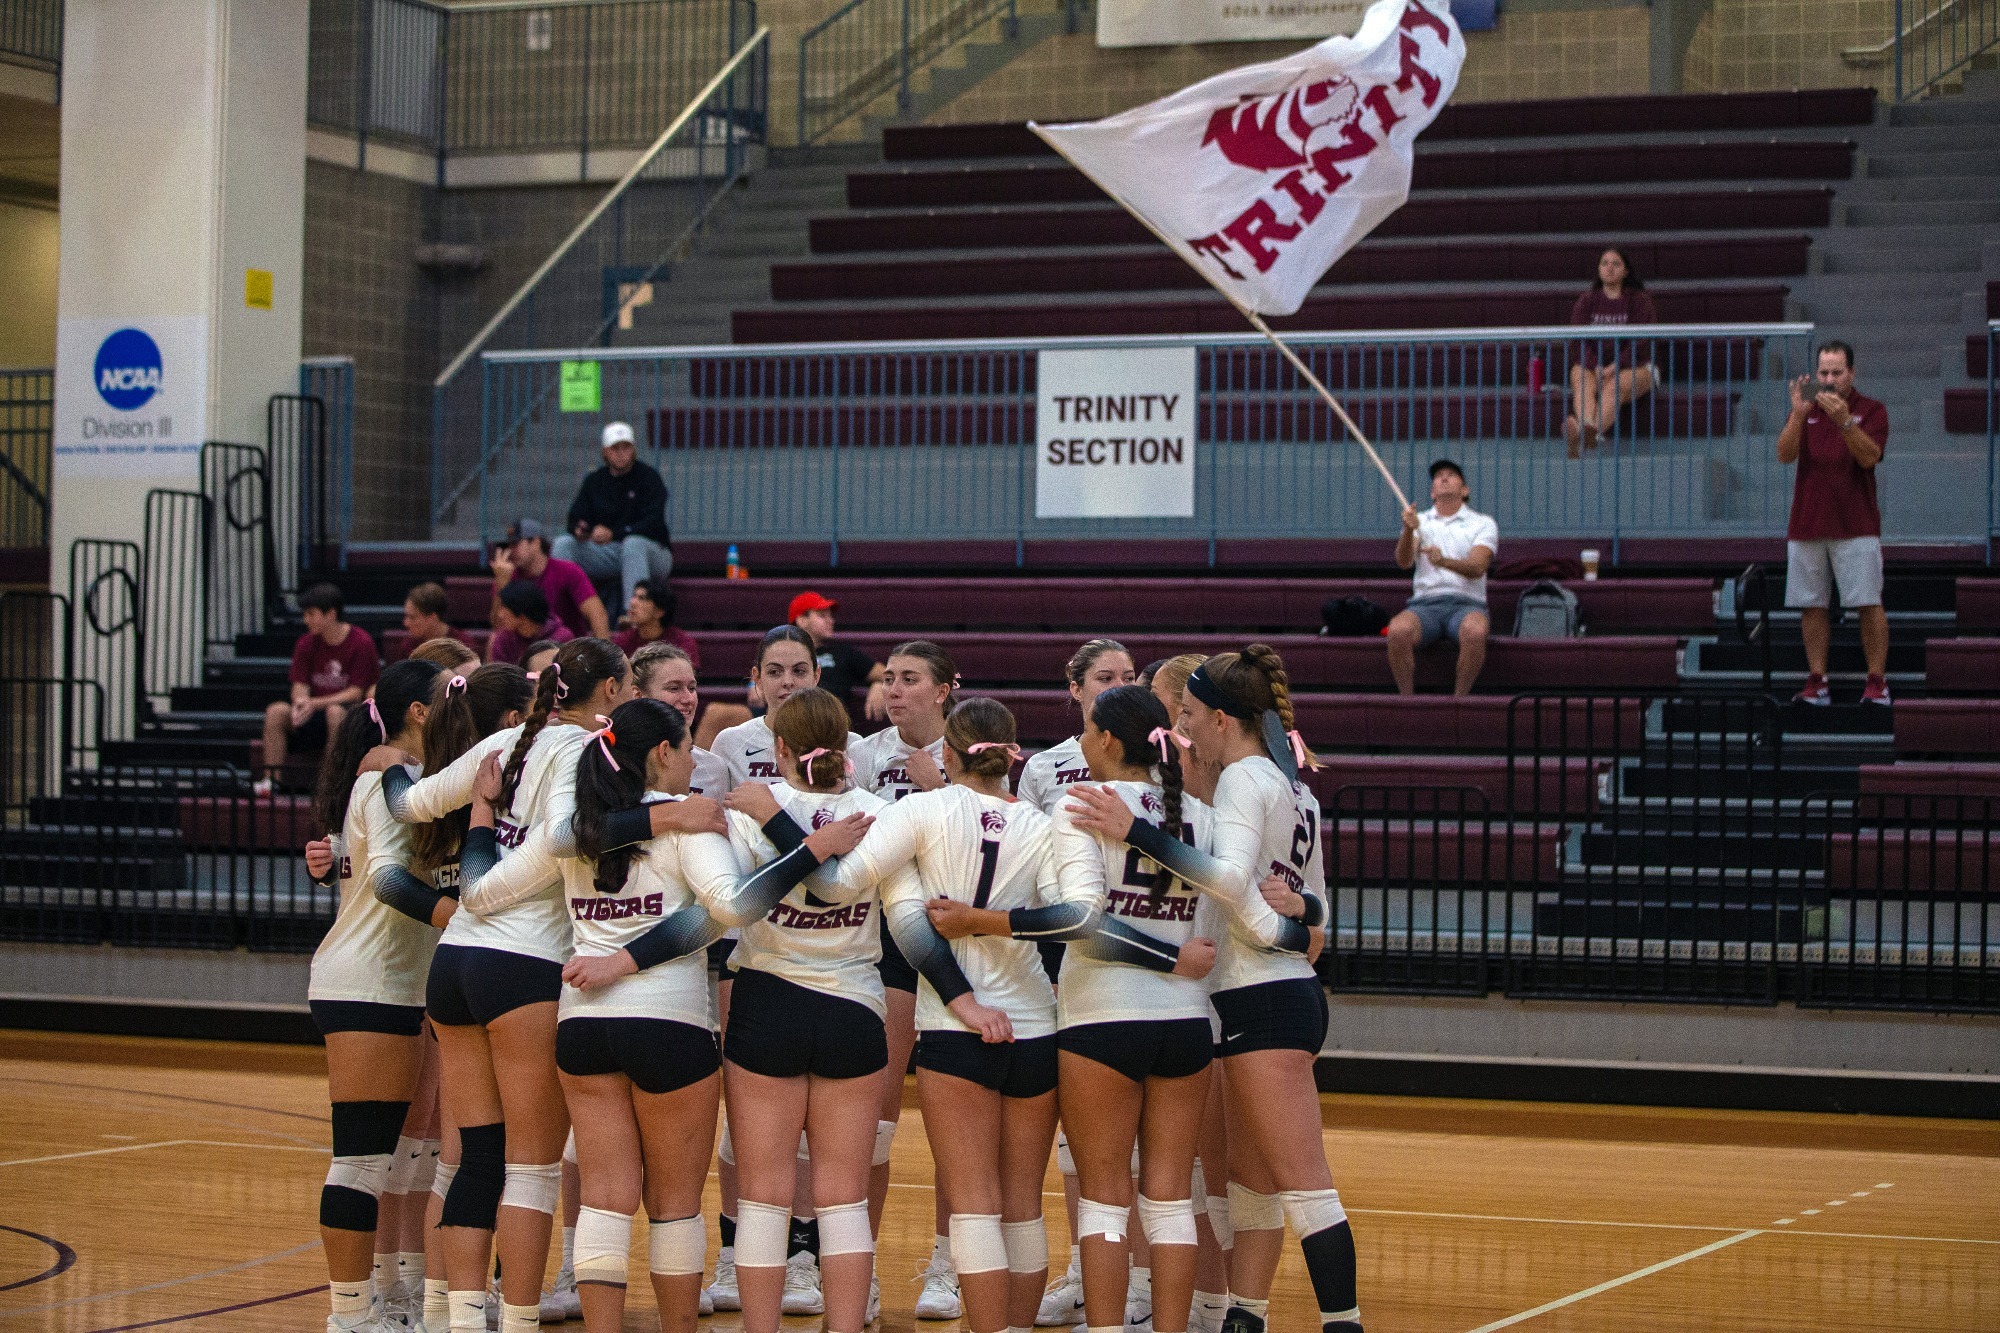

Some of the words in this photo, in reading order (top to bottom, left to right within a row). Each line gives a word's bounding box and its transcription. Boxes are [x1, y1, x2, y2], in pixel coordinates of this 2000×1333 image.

[101, 367, 160, 391] NCAA
[1053, 394, 1180, 423] TRINITY
[83, 417, 153, 439] Division
[1047, 437, 1184, 466] SECTION
[571, 892, 664, 921] TIGERS
[767, 902, 872, 929] TIGERS
[1105, 889, 1198, 922] TIGERS
